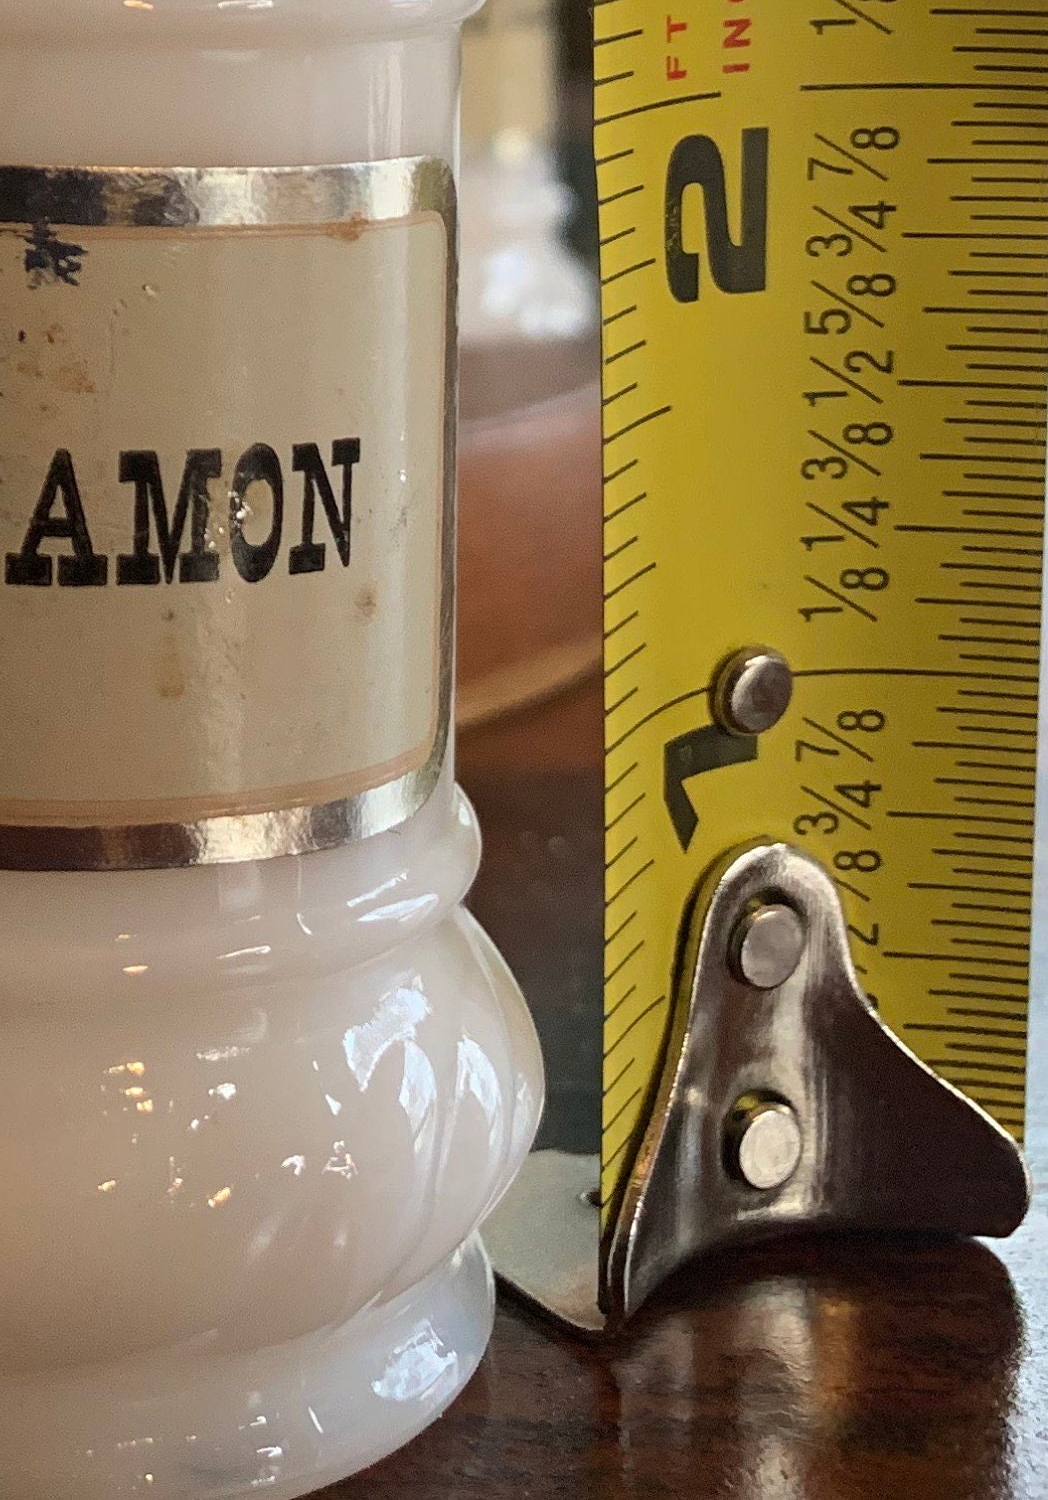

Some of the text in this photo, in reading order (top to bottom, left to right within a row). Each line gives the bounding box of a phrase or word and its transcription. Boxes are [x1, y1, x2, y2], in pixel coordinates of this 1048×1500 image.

[666, 14, 690, 81] FT
[807, 126, 900, 182] 7/8
[664, 127, 769, 303] 2
[805, 201, 898, 257] 3/4
[804, 273, 897, 334] 5/8
[803, 350, 895, 406] 1/2
[801, 421, 894, 480] 3/8
[800, 497, 890, 549] 1/4
[798, 567, 890, 623] 1/8
[796, 708, 886, 762] 7/8
[663, 723, 758, 854] 1
[794, 781, 882, 835] 3/4
